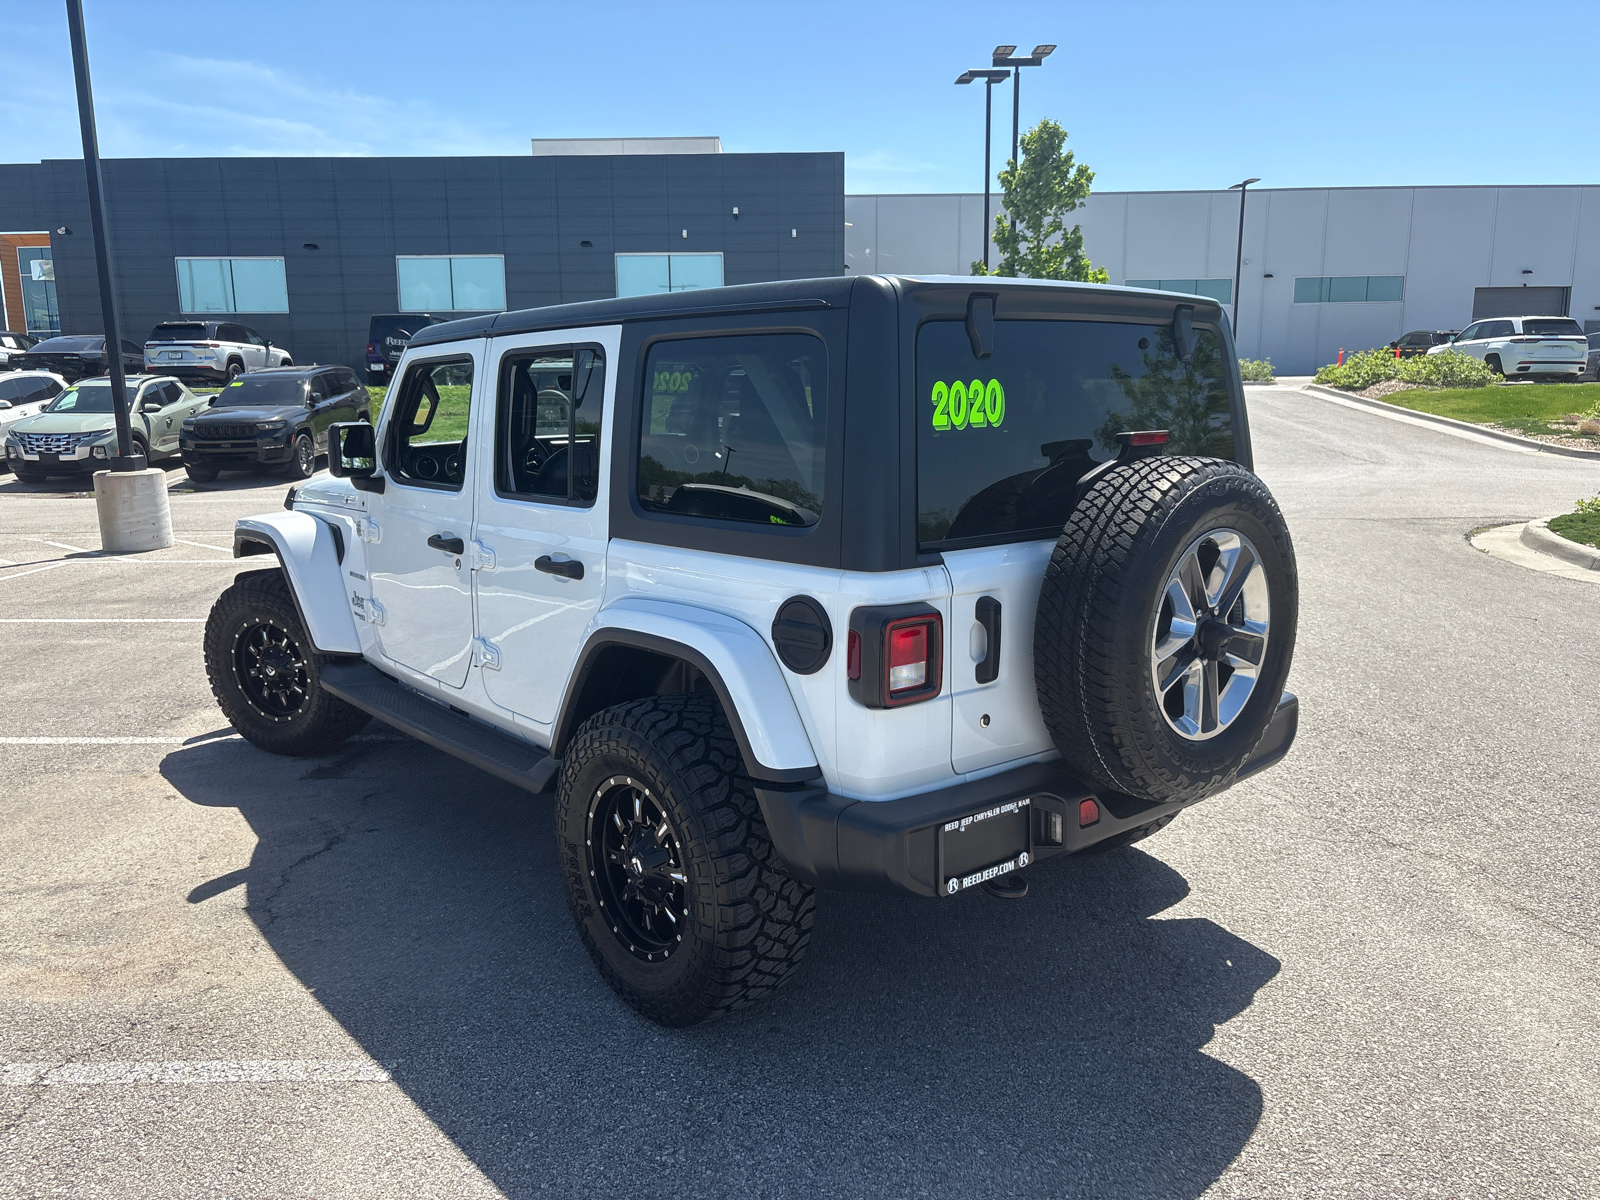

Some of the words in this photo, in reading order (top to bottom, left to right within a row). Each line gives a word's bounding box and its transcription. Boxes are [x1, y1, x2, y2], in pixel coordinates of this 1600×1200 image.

[931, 378, 1005, 431] 2020
[944, 820, 959, 832] REED
[960, 816, 973, 828] JEEP
[973, 807, 1000, 823] CHRYSLER
[1000, 801, 1018, 814] DODGE
[1018, 798, 1031, 808] RAM
[568, 843, 593, 917] KENDA
[962, 860, 1015, 889] REEDJEEP.COM
